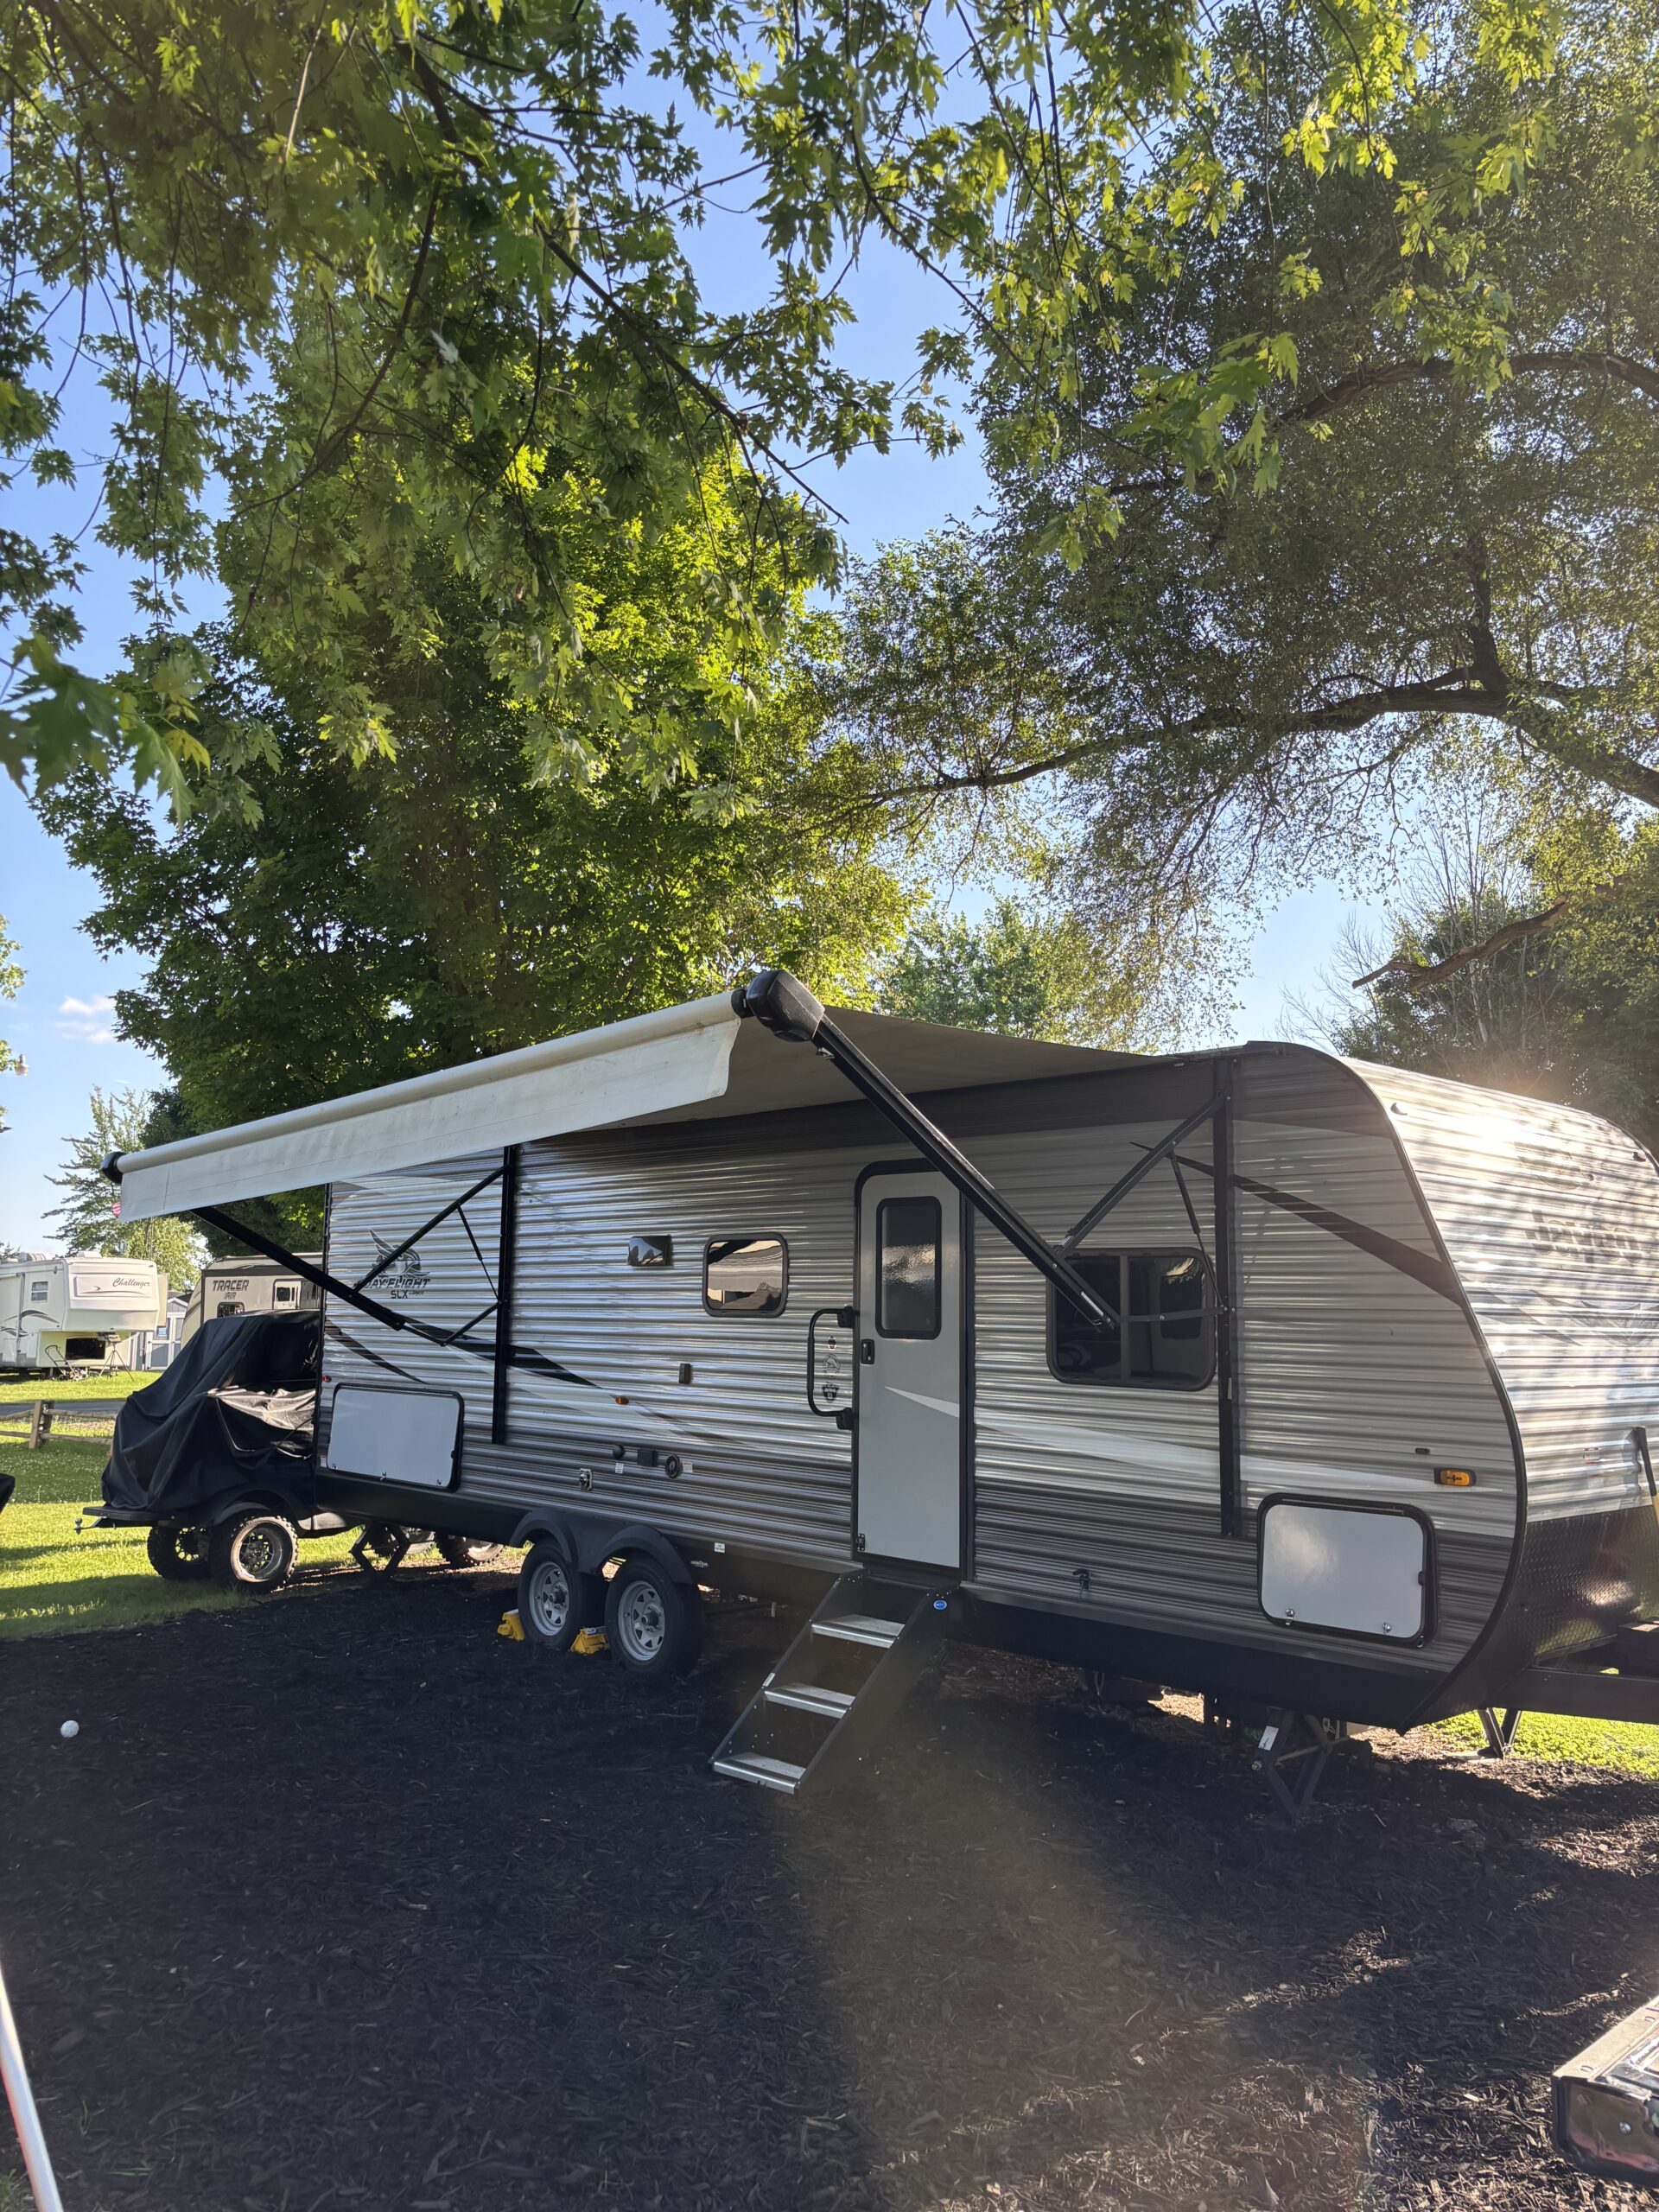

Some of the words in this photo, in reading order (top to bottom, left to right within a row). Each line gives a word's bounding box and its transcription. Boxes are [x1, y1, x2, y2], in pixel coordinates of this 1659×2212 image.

[112, 1277, 150, 1288] Challenger
[213, 1280, 249, 1291] TRACER
[387, 1278, 431, 1288] FLIGHT
[391, 1290, 408, 1299] SLX
